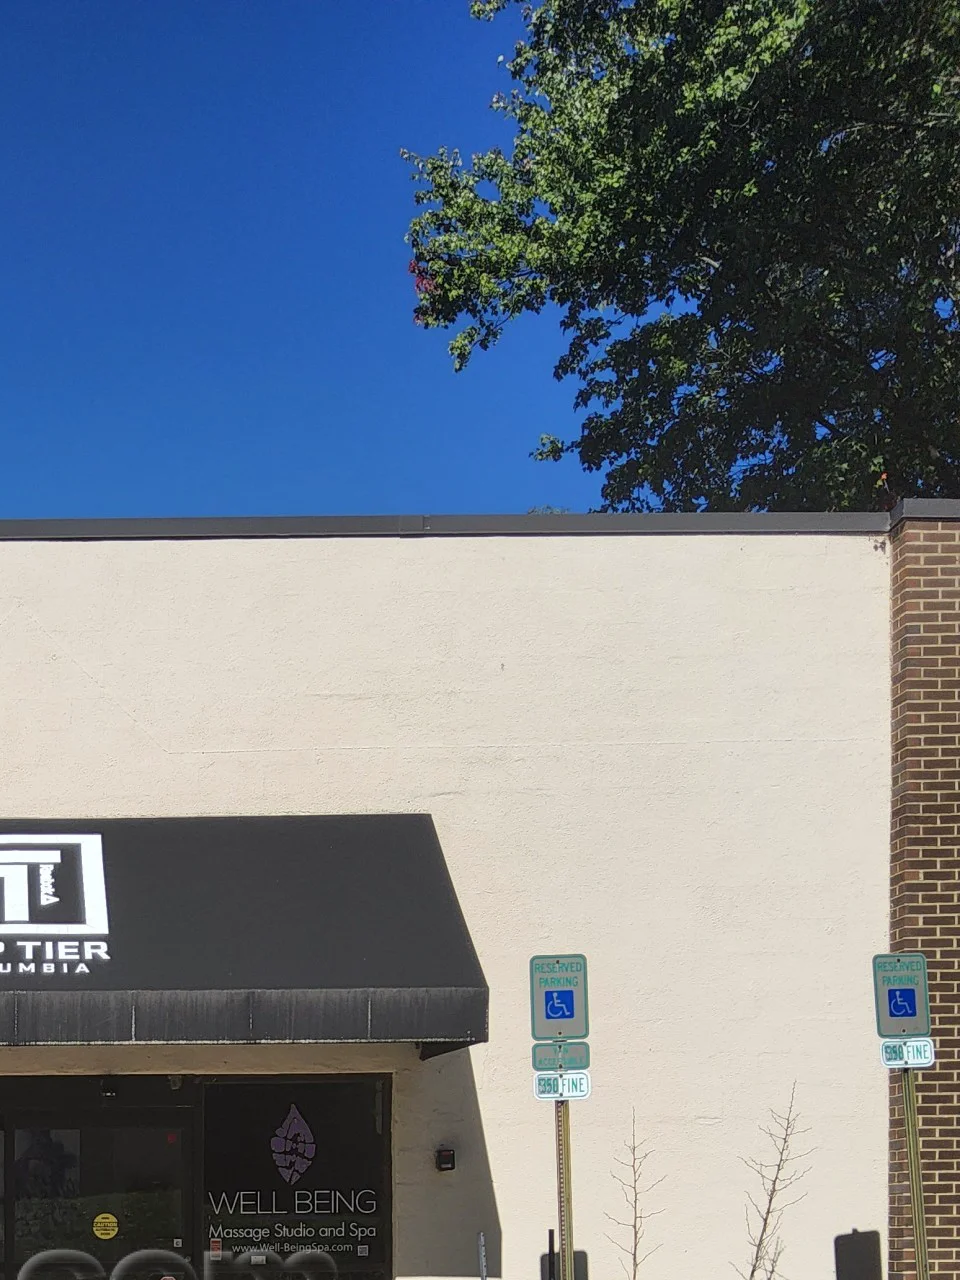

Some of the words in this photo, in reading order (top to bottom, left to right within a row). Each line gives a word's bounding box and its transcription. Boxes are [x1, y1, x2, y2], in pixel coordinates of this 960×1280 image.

[16, 941, 111, 960] TIER
[535, 962, 582, 973] RESERVED
[877, 961, 921, 972] RESERVED
[539, 976, 579, 988] PARKING
[882, 975, 920, 986] PARKING
[907, 1044, 929, 1060] FINE
[562, 1078, 585, 1093] FINE
[208, 1191, 288, 1215] WELL
[295, 1189, 377, 1214] BEING
[209, 1224, 270, 1241] Massage
[274, 1222, 316, 1238] Studio
[319, 1222, 345, 1237] and
[349, 1223, 377, 1241] Spa
